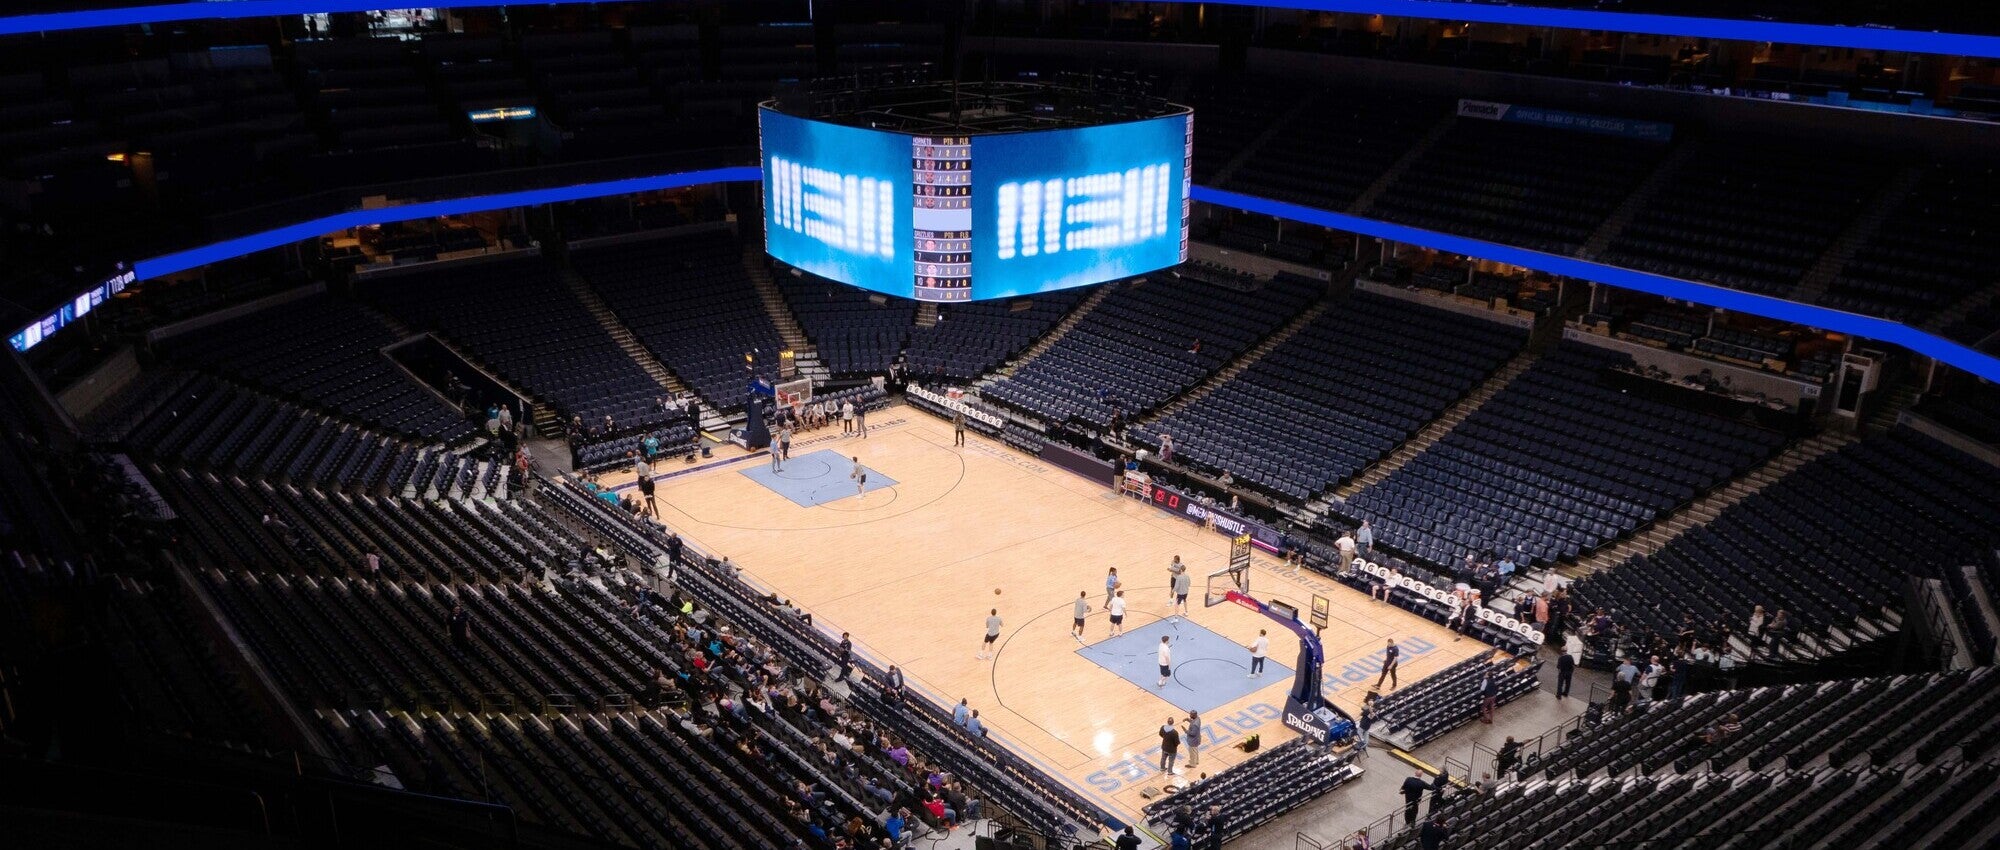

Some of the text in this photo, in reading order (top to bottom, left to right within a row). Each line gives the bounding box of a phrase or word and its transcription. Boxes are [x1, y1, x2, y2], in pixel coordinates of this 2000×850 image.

[1462, 101, 1499, 116] Pinnacle
[960, 137, 968, 145] FLS
[1286, 712, 1326, 742] SPALDING
